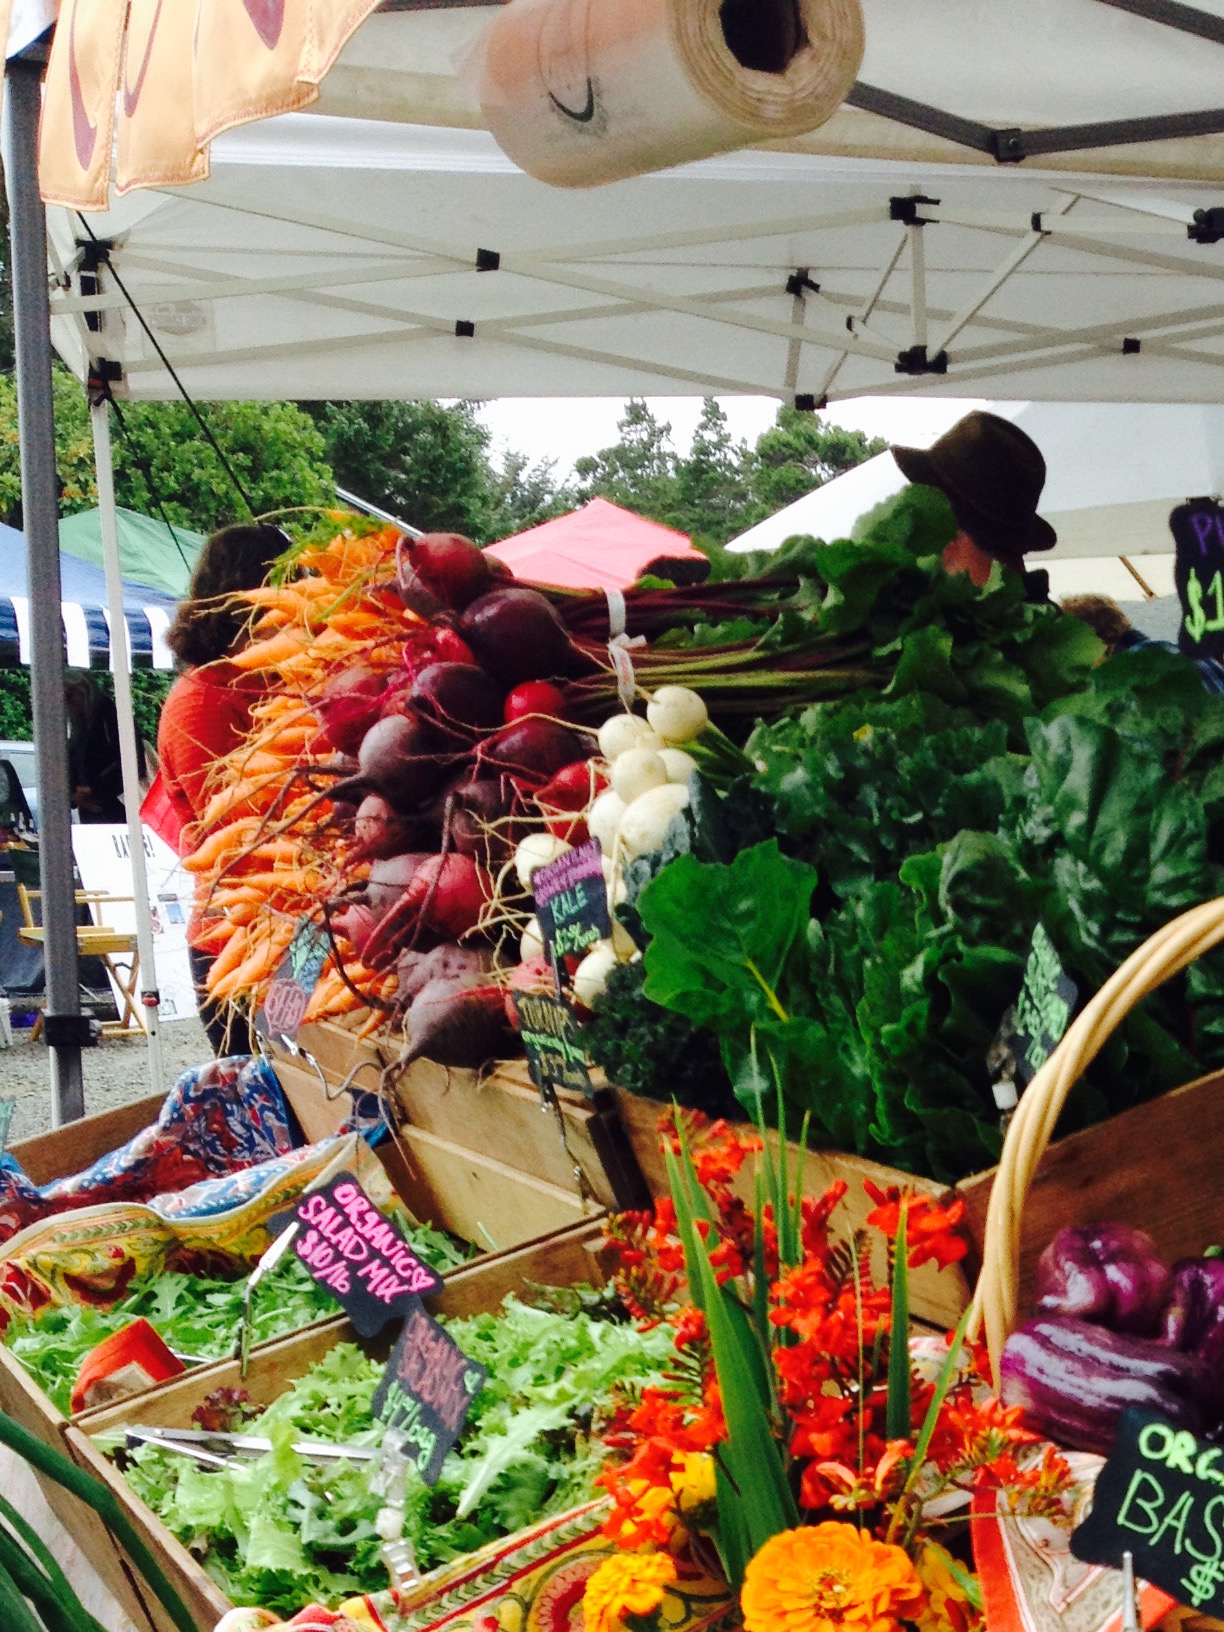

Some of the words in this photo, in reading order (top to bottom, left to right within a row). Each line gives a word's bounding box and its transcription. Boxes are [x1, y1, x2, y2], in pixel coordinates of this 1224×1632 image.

[550, 882, 588, 925] KALE
[298, 1194, 369, 1262] SALAD
[356, 1258, 410, 1305] MIX
